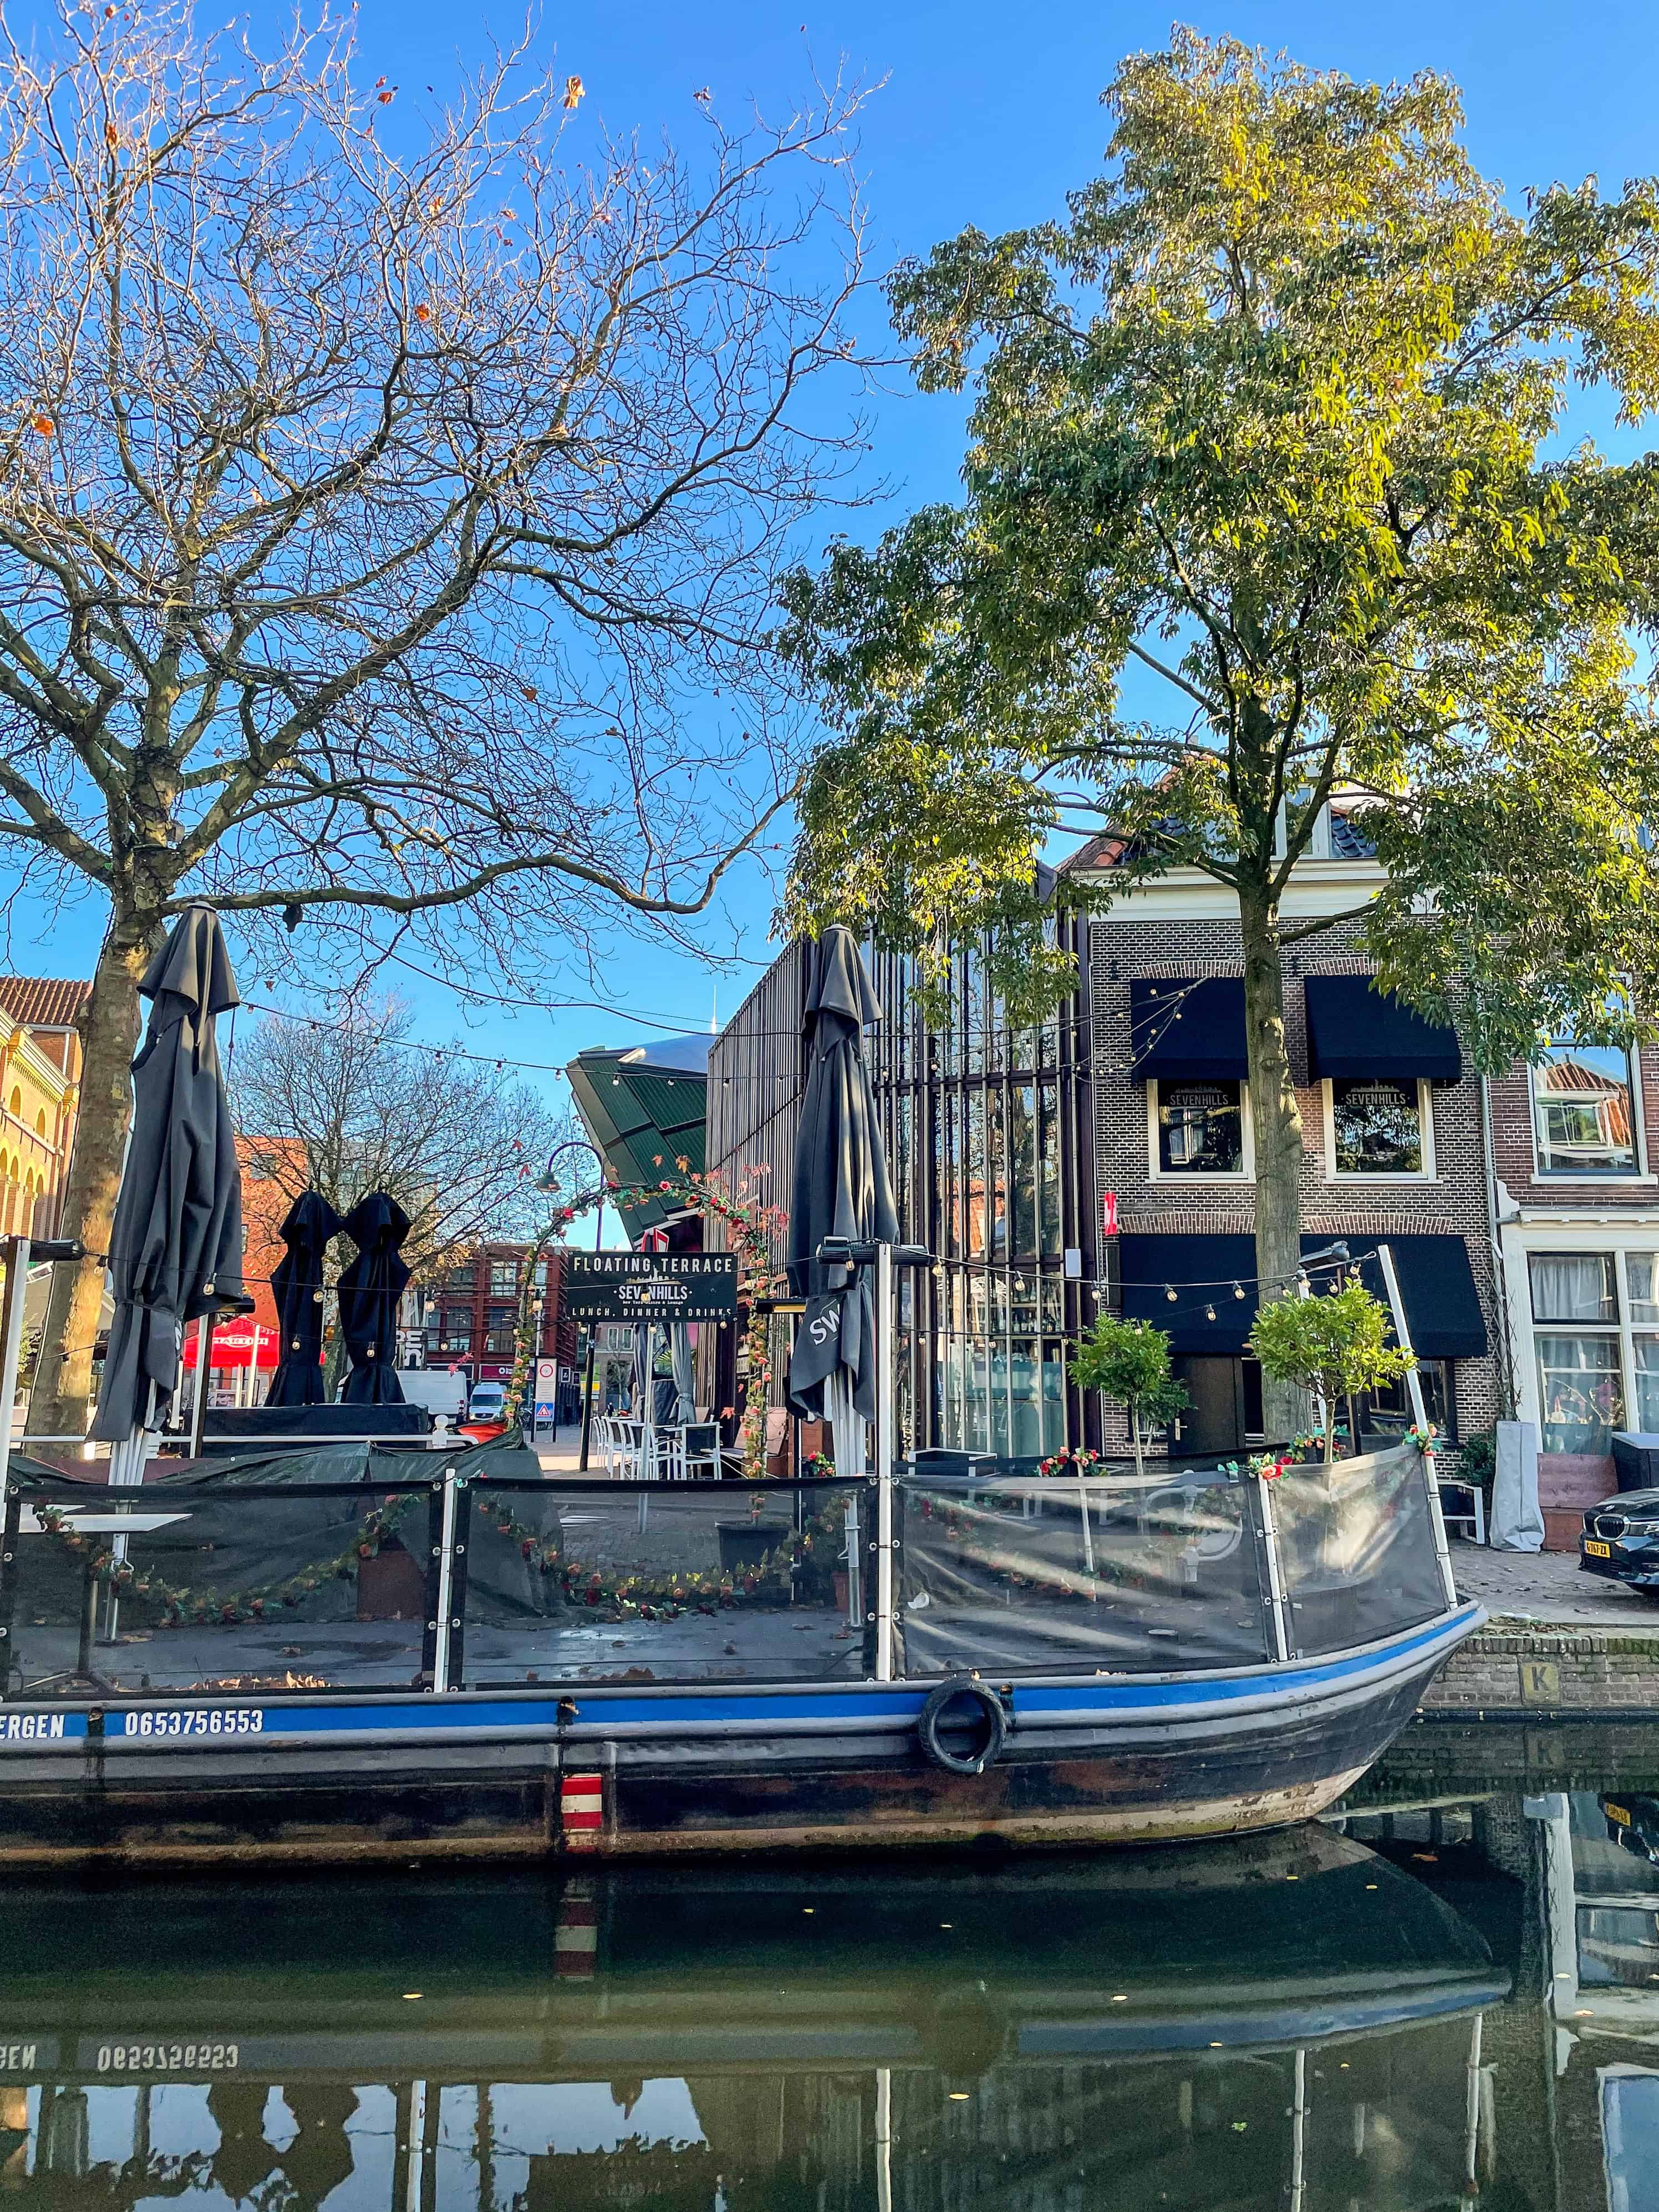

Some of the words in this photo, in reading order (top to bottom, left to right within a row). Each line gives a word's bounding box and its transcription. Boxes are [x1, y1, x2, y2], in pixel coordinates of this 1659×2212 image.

[1169, 1095, 1229, 1105] SEVENHILLS
[1345, 1093, 1406, 1105] SEVENHILLS
[573, 1257, 651, 1272] FLOATING
[661, 1258, 732, 1273] TERRACE
[618, 1285, 688, 1300] SEVNHILLS
[623, 1308, 667, 1316] DINNER
[674, 1308, 680, 1316] &
[688, 1308, 731, 1317] DRINKS
[1531, 1666, 1550, 1691] K
[125, 1710, 263, 1736] 0653756553
